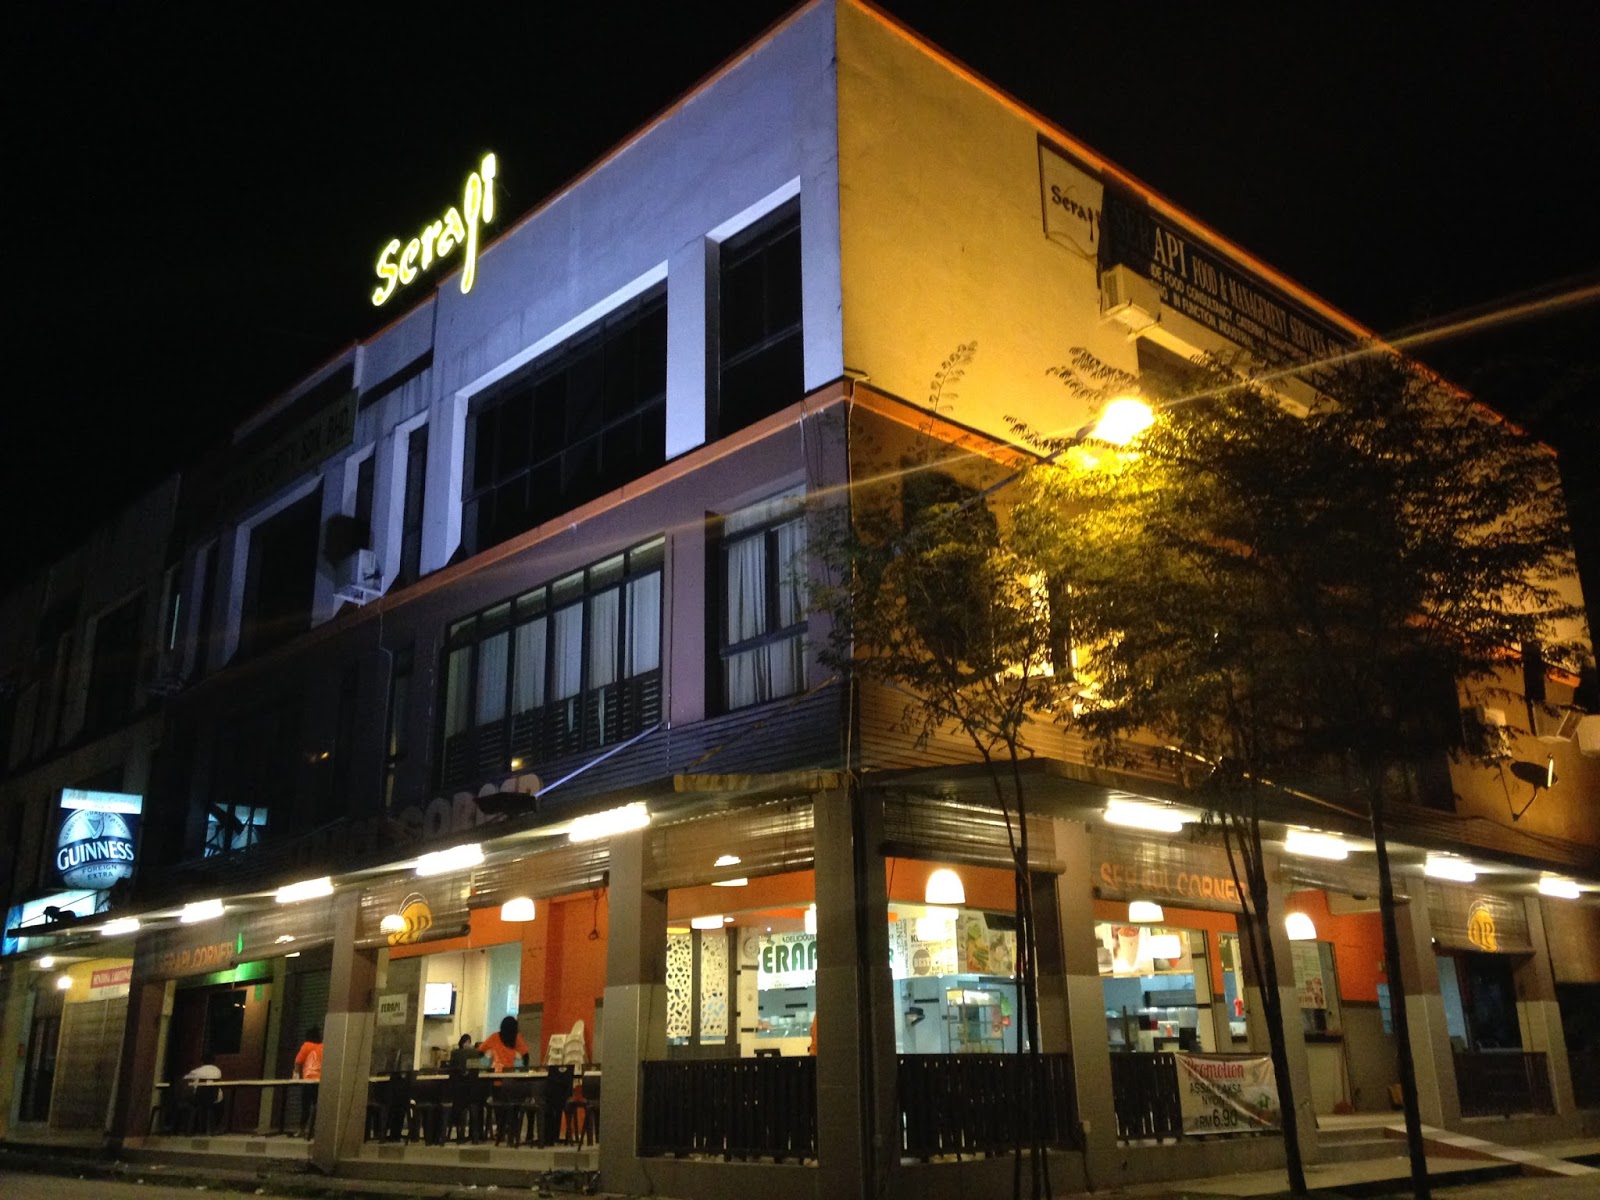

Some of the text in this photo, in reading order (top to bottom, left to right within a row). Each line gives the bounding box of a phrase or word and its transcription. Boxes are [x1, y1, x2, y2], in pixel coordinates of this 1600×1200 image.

[57, 840, 134, 871] GUINNESS
[82, 864, 117, 875] FOREIGN
[88, 871, 114, 881] EXTRA
